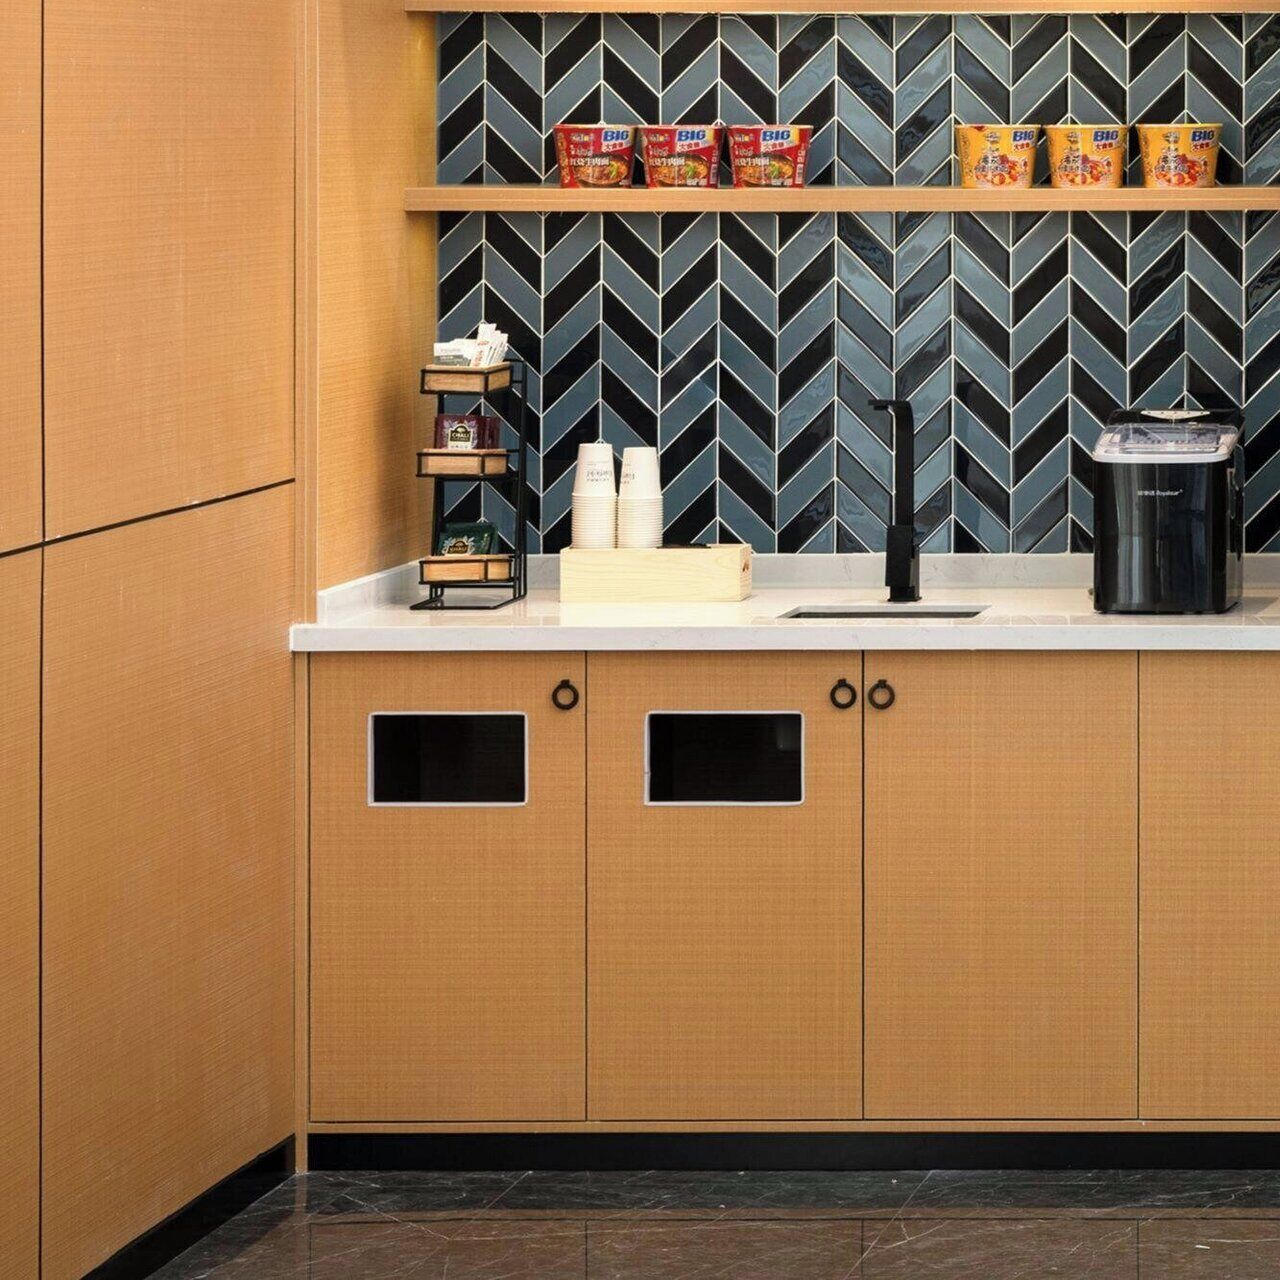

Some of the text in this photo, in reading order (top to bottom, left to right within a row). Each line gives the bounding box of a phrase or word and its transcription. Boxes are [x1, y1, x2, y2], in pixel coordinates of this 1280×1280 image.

[603, 130, 629, 141] BIG
[677, 130, 706, 141] BIG
[762, 130, 790, 141] BIG
[1094, 130, 1118, 142] BIG
